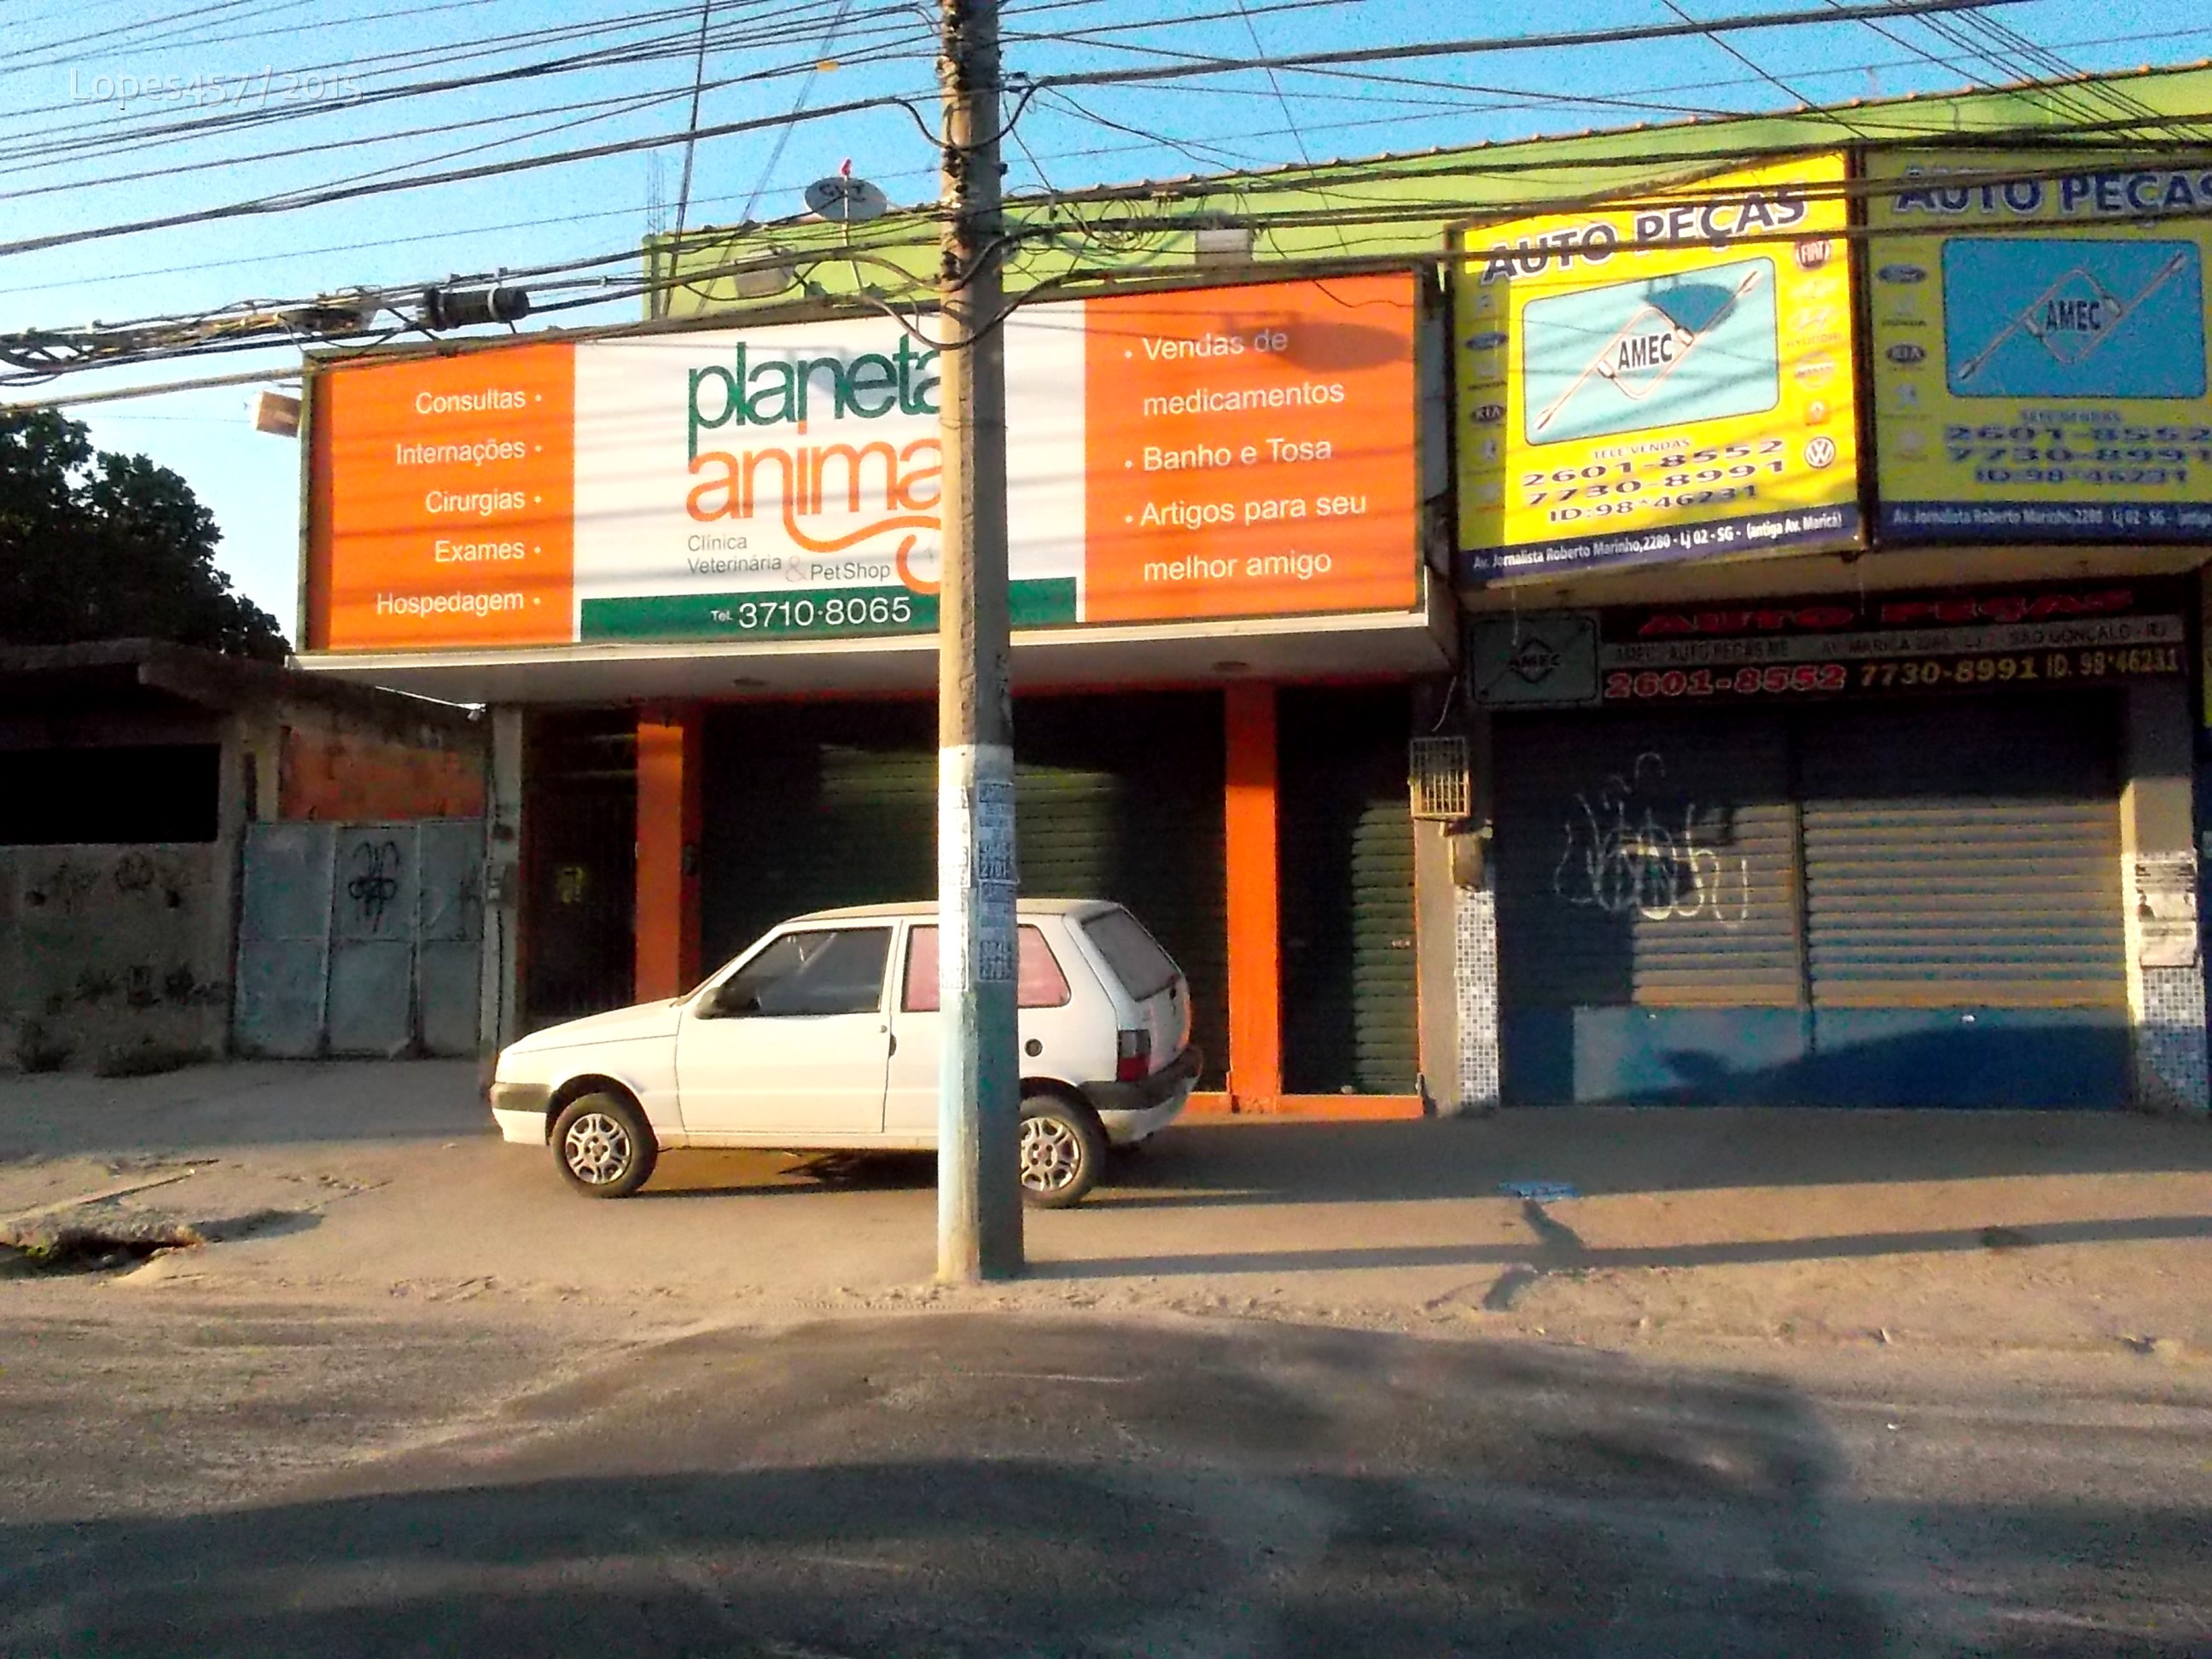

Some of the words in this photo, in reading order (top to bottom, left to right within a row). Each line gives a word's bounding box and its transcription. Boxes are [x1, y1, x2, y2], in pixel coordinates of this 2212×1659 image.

[1893, 165, 2045, 214] AUTO
[1481, 224, 1617, 285] AUTO
[1633, 185, 1808, 253] PEÇAS
[2046, 300, 2102, 332] AMEC
[1142, 333, 1244, 362] Vendas
[1254, 328, 1288, 353] de
[1618, 333, 1674, 371] AMEC
[416, 389, 527, 415] Consultas
[1144, 381, 1345, 416] medicamentos
[396, 439, 526, 468] Internações
[1144, 443, 1231, 472] Banho
[1240, 444, 1257, 464] e
[1266, 437, 1332, 463] Tosa
[1522, 439, 1784, 487] 2601-8552
[1629, 438, 1691, 454] VENDAS
[686, 438, 942, 526] anima
[1527, 459, 1784, 506] 7730-8991
[425, 490, 526, 518] Cirurgias
[1139, 501, 1236, 530] Artigos
[1244, 498, 1306, 526] para
[1316, 495, 1366, 517] seu
[434, 539, 525, 562] Exames
[687, 533, 748, 552] Clínica
[1493, 549, 1544, 568] Jornalista
[1546, 544, 1591, 562] Roberto
[1693, 531, 1708, 544] 02
[1717, 527, 1734, 542] SG
[687, 554, 783, 575] Veterinária
[1144, 555, 1238, 581] melhor
[1245, 550, 1332, 579] amigo
[376, 590, 524, 618] Hospedagem
[1604, 663, 1845, 698] 2601-8552
[1860, 655, 2039, 686] 7730-8991
